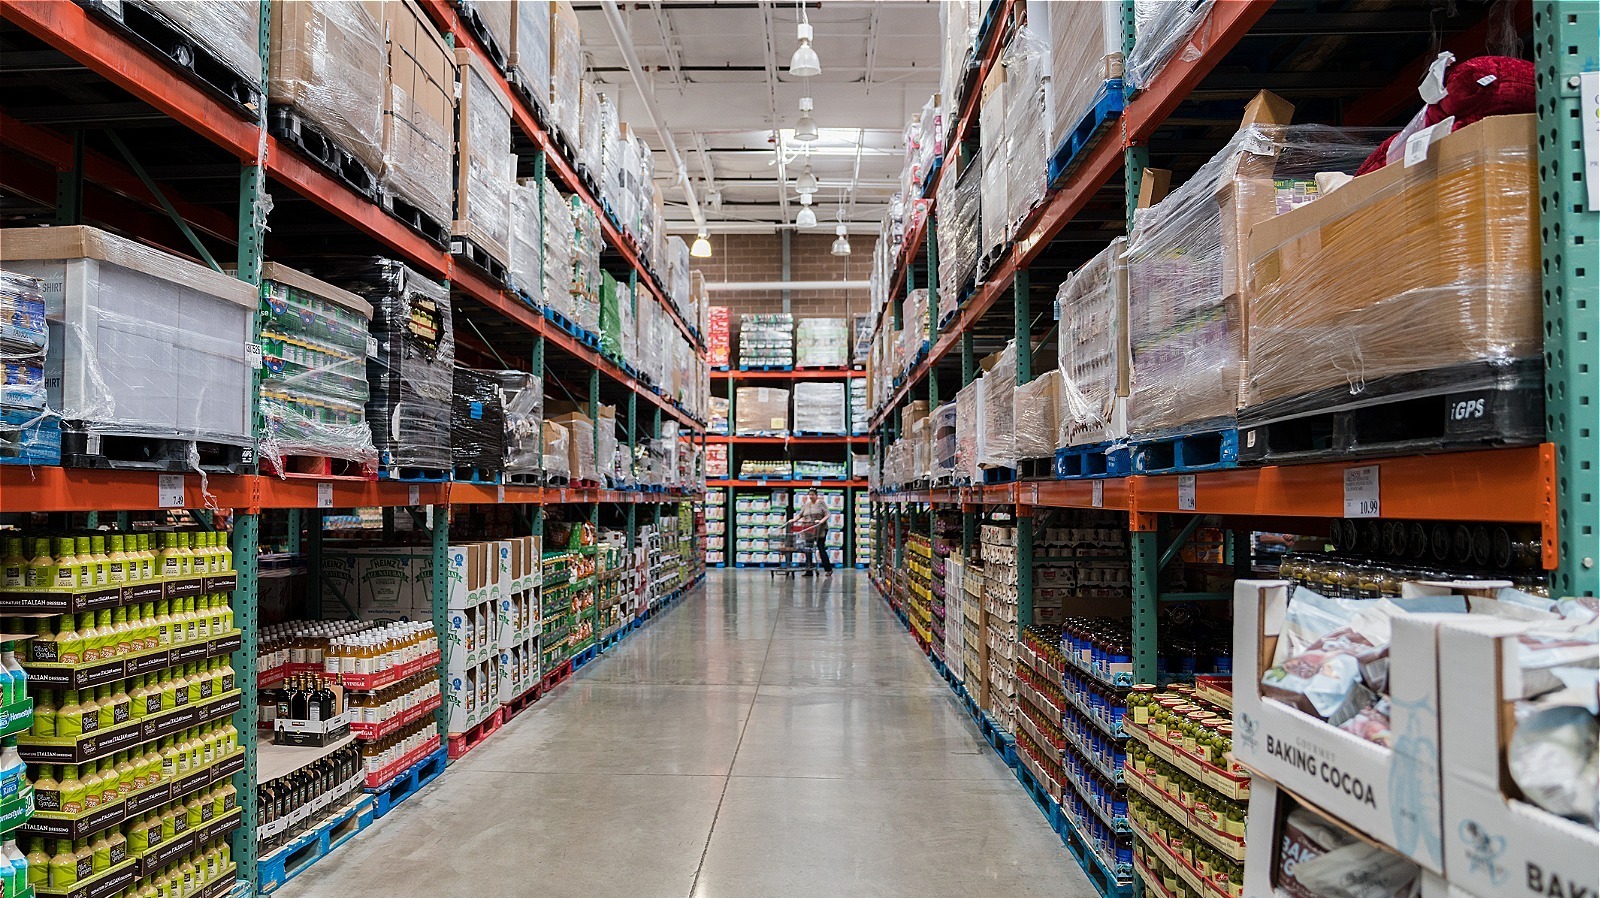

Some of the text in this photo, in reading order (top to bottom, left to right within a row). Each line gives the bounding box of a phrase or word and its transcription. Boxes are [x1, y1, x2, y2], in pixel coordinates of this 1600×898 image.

[42, 282, 63, 292] SHIRT
[45, 378, 60, 388] HIRT
[1451, 398, 1485, 420] iGPS
[1360, 500, 1378, 514] 10.99
[374, 559, 397, 568] HEINZ
[380, 570, 404, 578] NATURAL
[34, 644, 48, 652] Olive
[35, 650, 57, 659] Garden
[1266, 734, 1376, 809] BAKING COCOA
[36, 793, 51, 801] Olive
[38, 799, 60, 808] Garden
